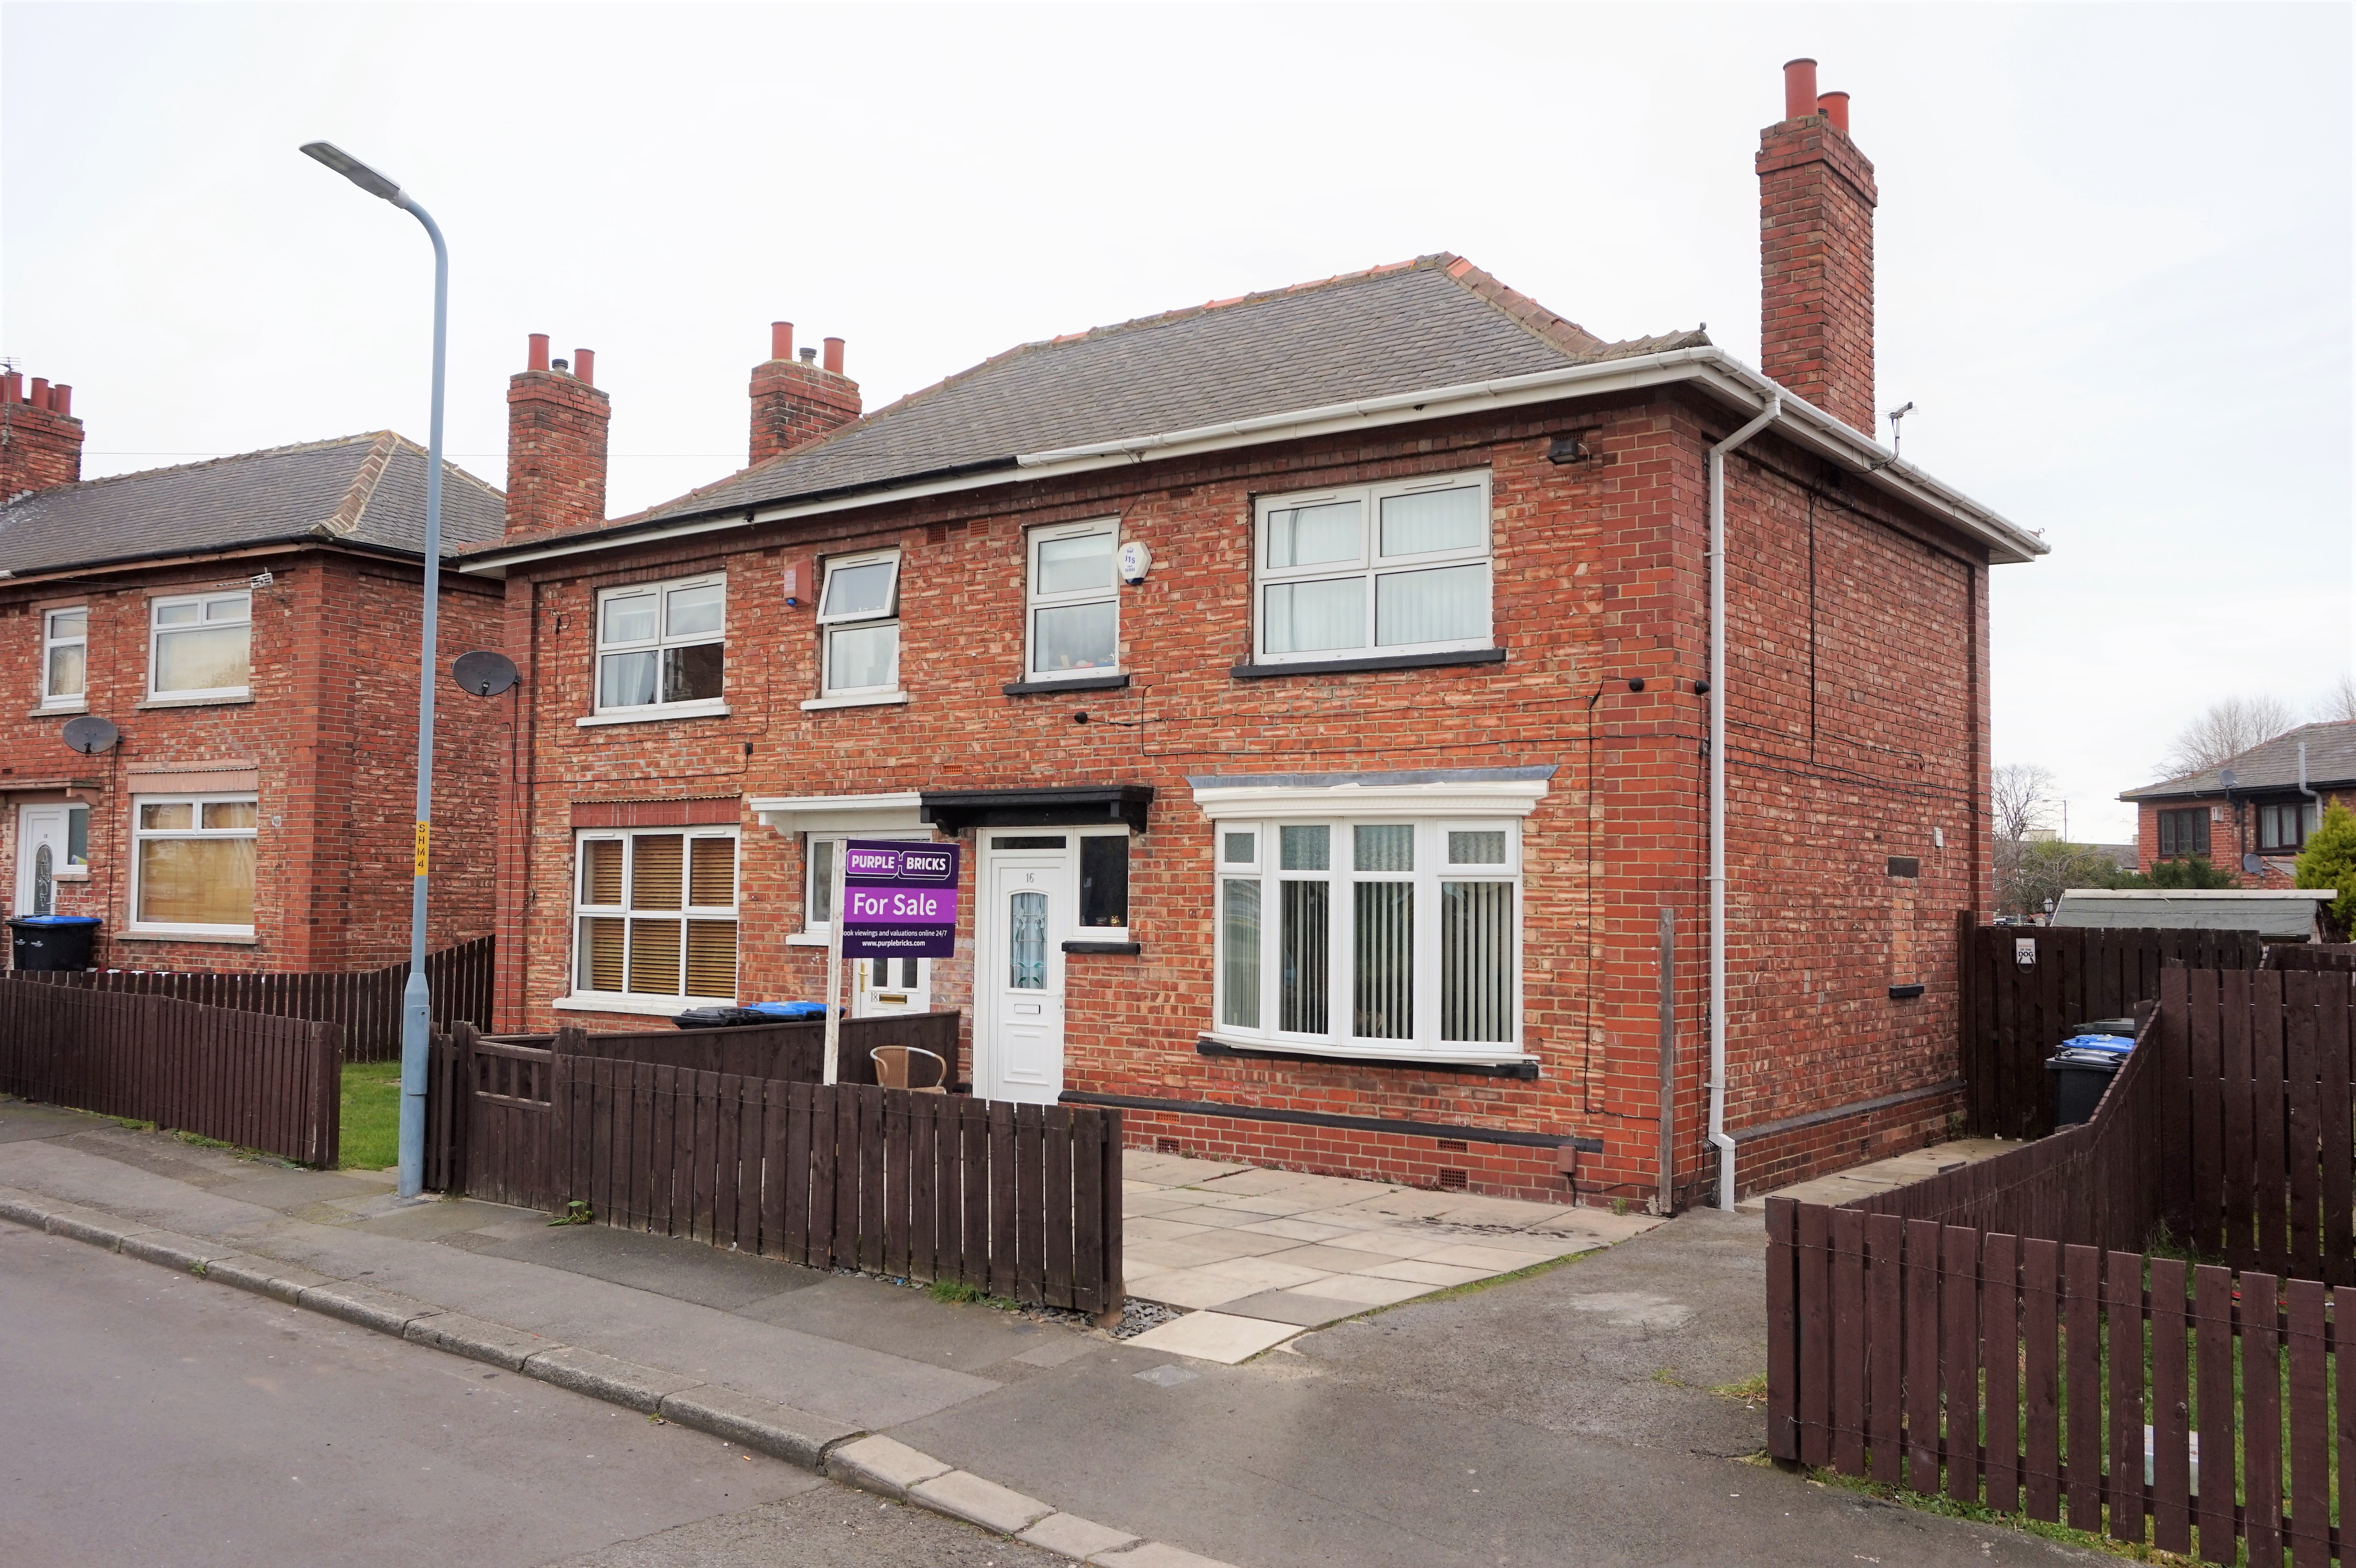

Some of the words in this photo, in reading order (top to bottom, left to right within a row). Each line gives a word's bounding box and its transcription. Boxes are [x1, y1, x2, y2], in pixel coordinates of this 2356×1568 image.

[1125, 555, 1135, 564] JTS
[851, 855, 895, 869] PURPLE
[906, 856, 946, 871] BRICKS
[1026, 872, 1034, 883] 16
[853, 893, 888, 915] For
[893, 893, 937, 916] Sale
[855, 930, 878, 938] viewings
[862, 939, 926, 948] www.purplebricks.com
[871, 992, 878, 1003] 18
